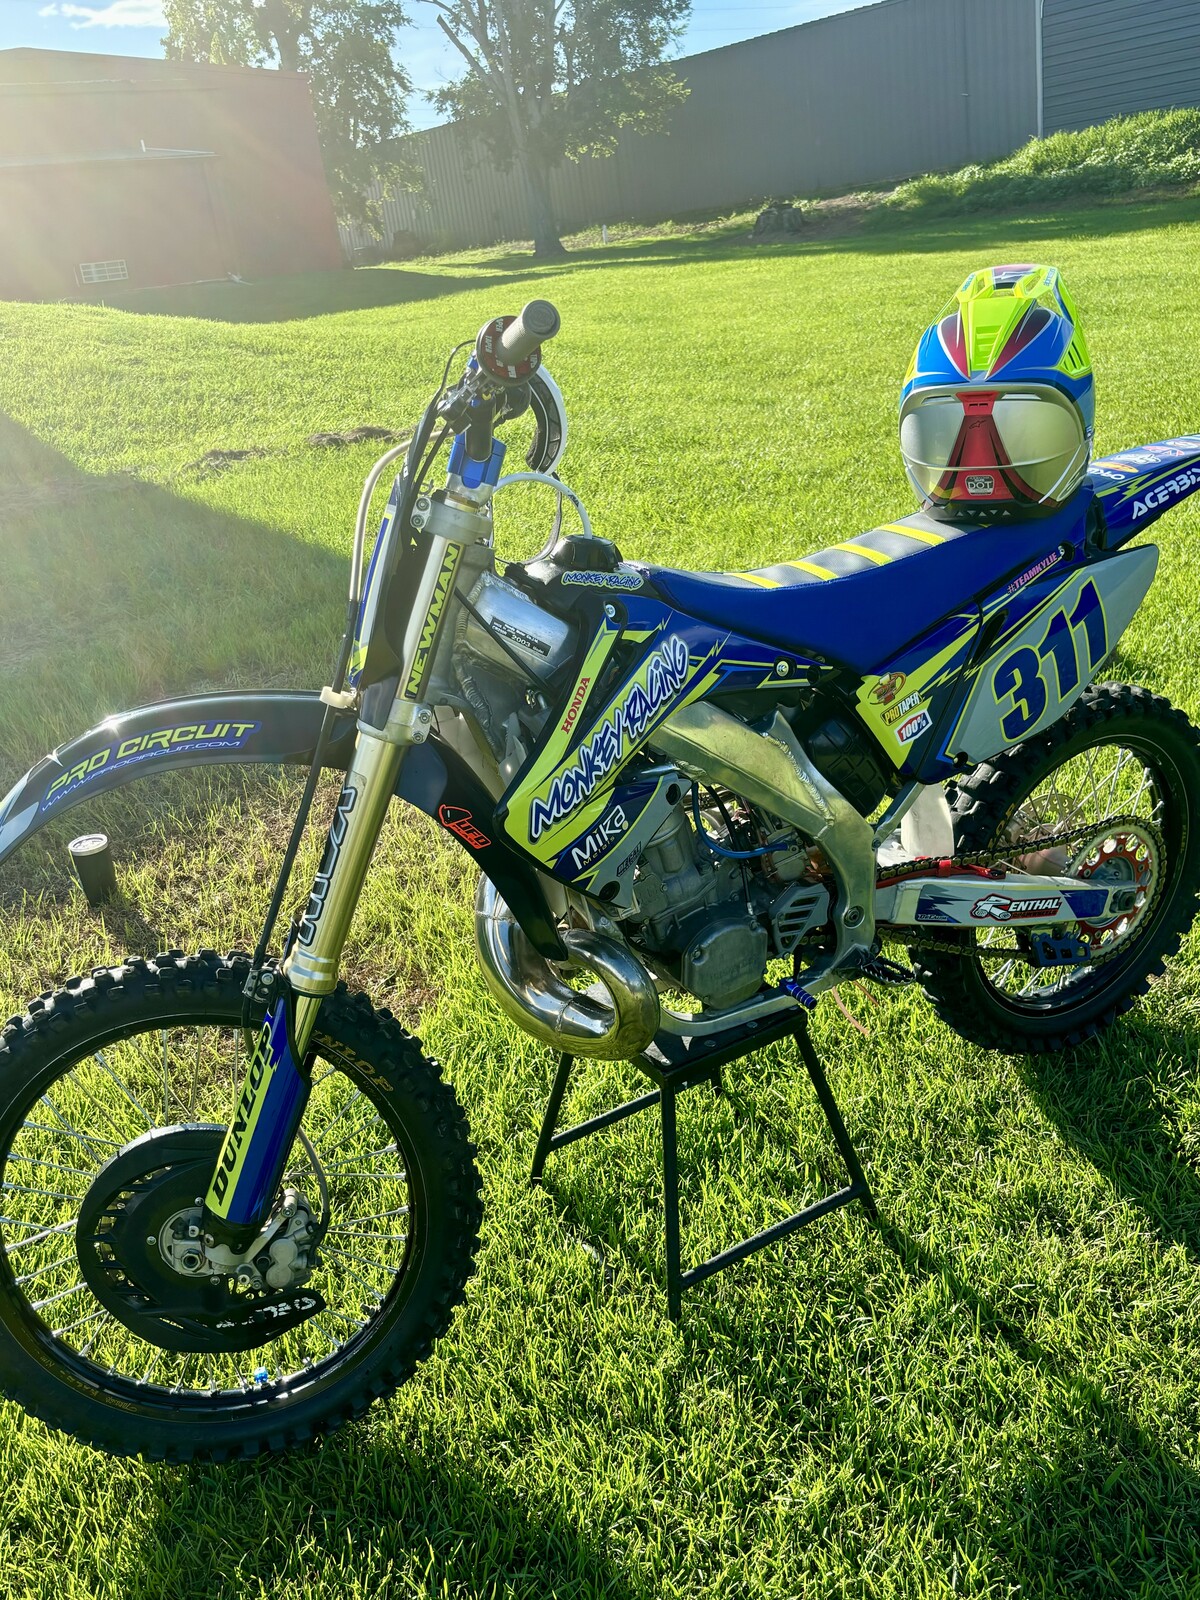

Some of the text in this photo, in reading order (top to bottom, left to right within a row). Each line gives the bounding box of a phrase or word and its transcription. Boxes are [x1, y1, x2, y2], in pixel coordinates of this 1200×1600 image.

[968, 481, 992, 490] DOT
[563, 572, 607, 586] MONKEY
[1007, 551, 1058, 594] #TEAMKYLIE
[407, 545, 460, 694] NEWMAN
[511, 634, 531, 648] 2003
[991, 576, 1109, 743] 311
[561, 677, 591, 735] HONDA
[900, 714, 927, 740] 100%
[41, 741, 241, 812] WWW.PROCIRCUIT.COM
[46, 723, 255, 800] PRO CIRCUIT
[531, 708, 622, 839] MONKEY
[455, 819, 490, 847] UFO
[212, 1022, 272, 1207] DUNLOP
